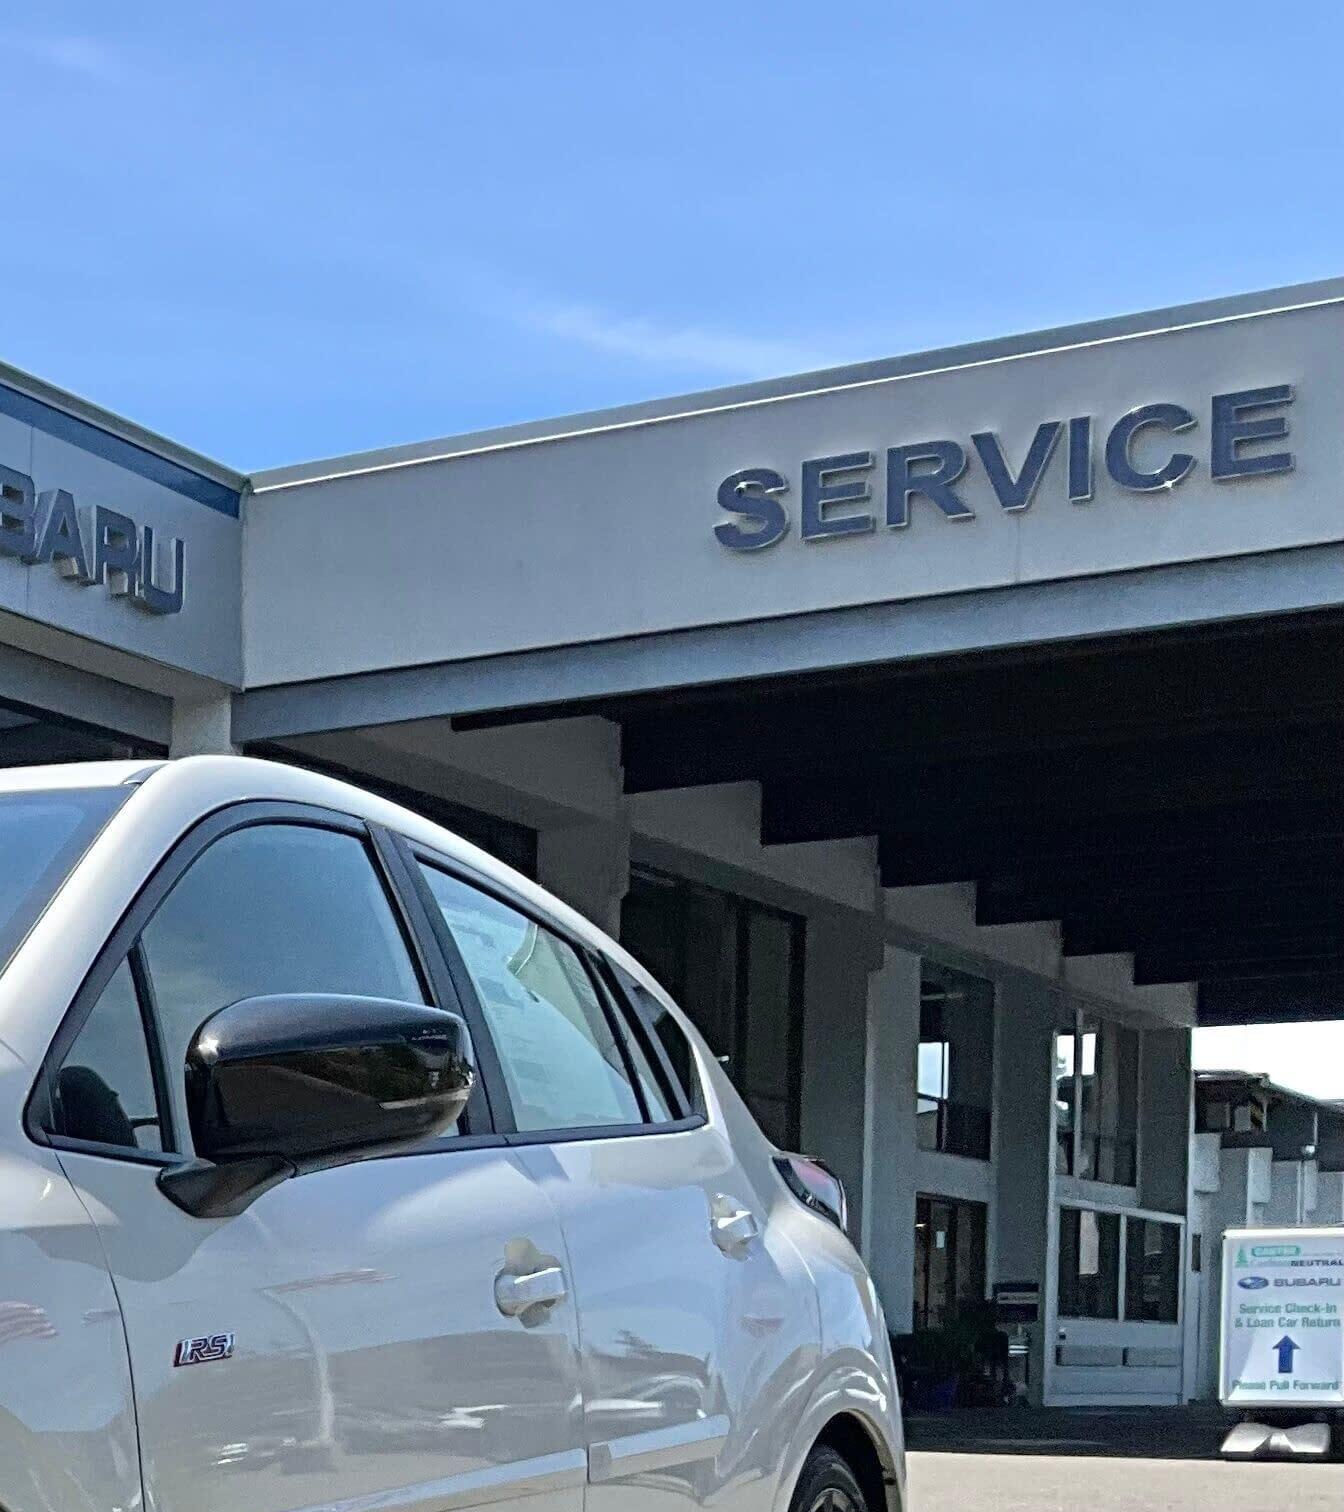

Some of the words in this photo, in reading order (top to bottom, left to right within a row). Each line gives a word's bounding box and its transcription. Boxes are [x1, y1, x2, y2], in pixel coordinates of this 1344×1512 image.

[712, 384, 1296, 551] SERVICE
[1273, 1277, 1342, 1288] SUBARU
[1239, 1303, 1282, 1314] Service
[1247, 1318, 1275, 1329] Loan
[1278, 1317, 1298, 1329] Car
[1301, 1317, 1341, 1329] Return
[1270, 1380, 1290, 1390] Pull
[1294, 1380, 1340, 1390] Forward
